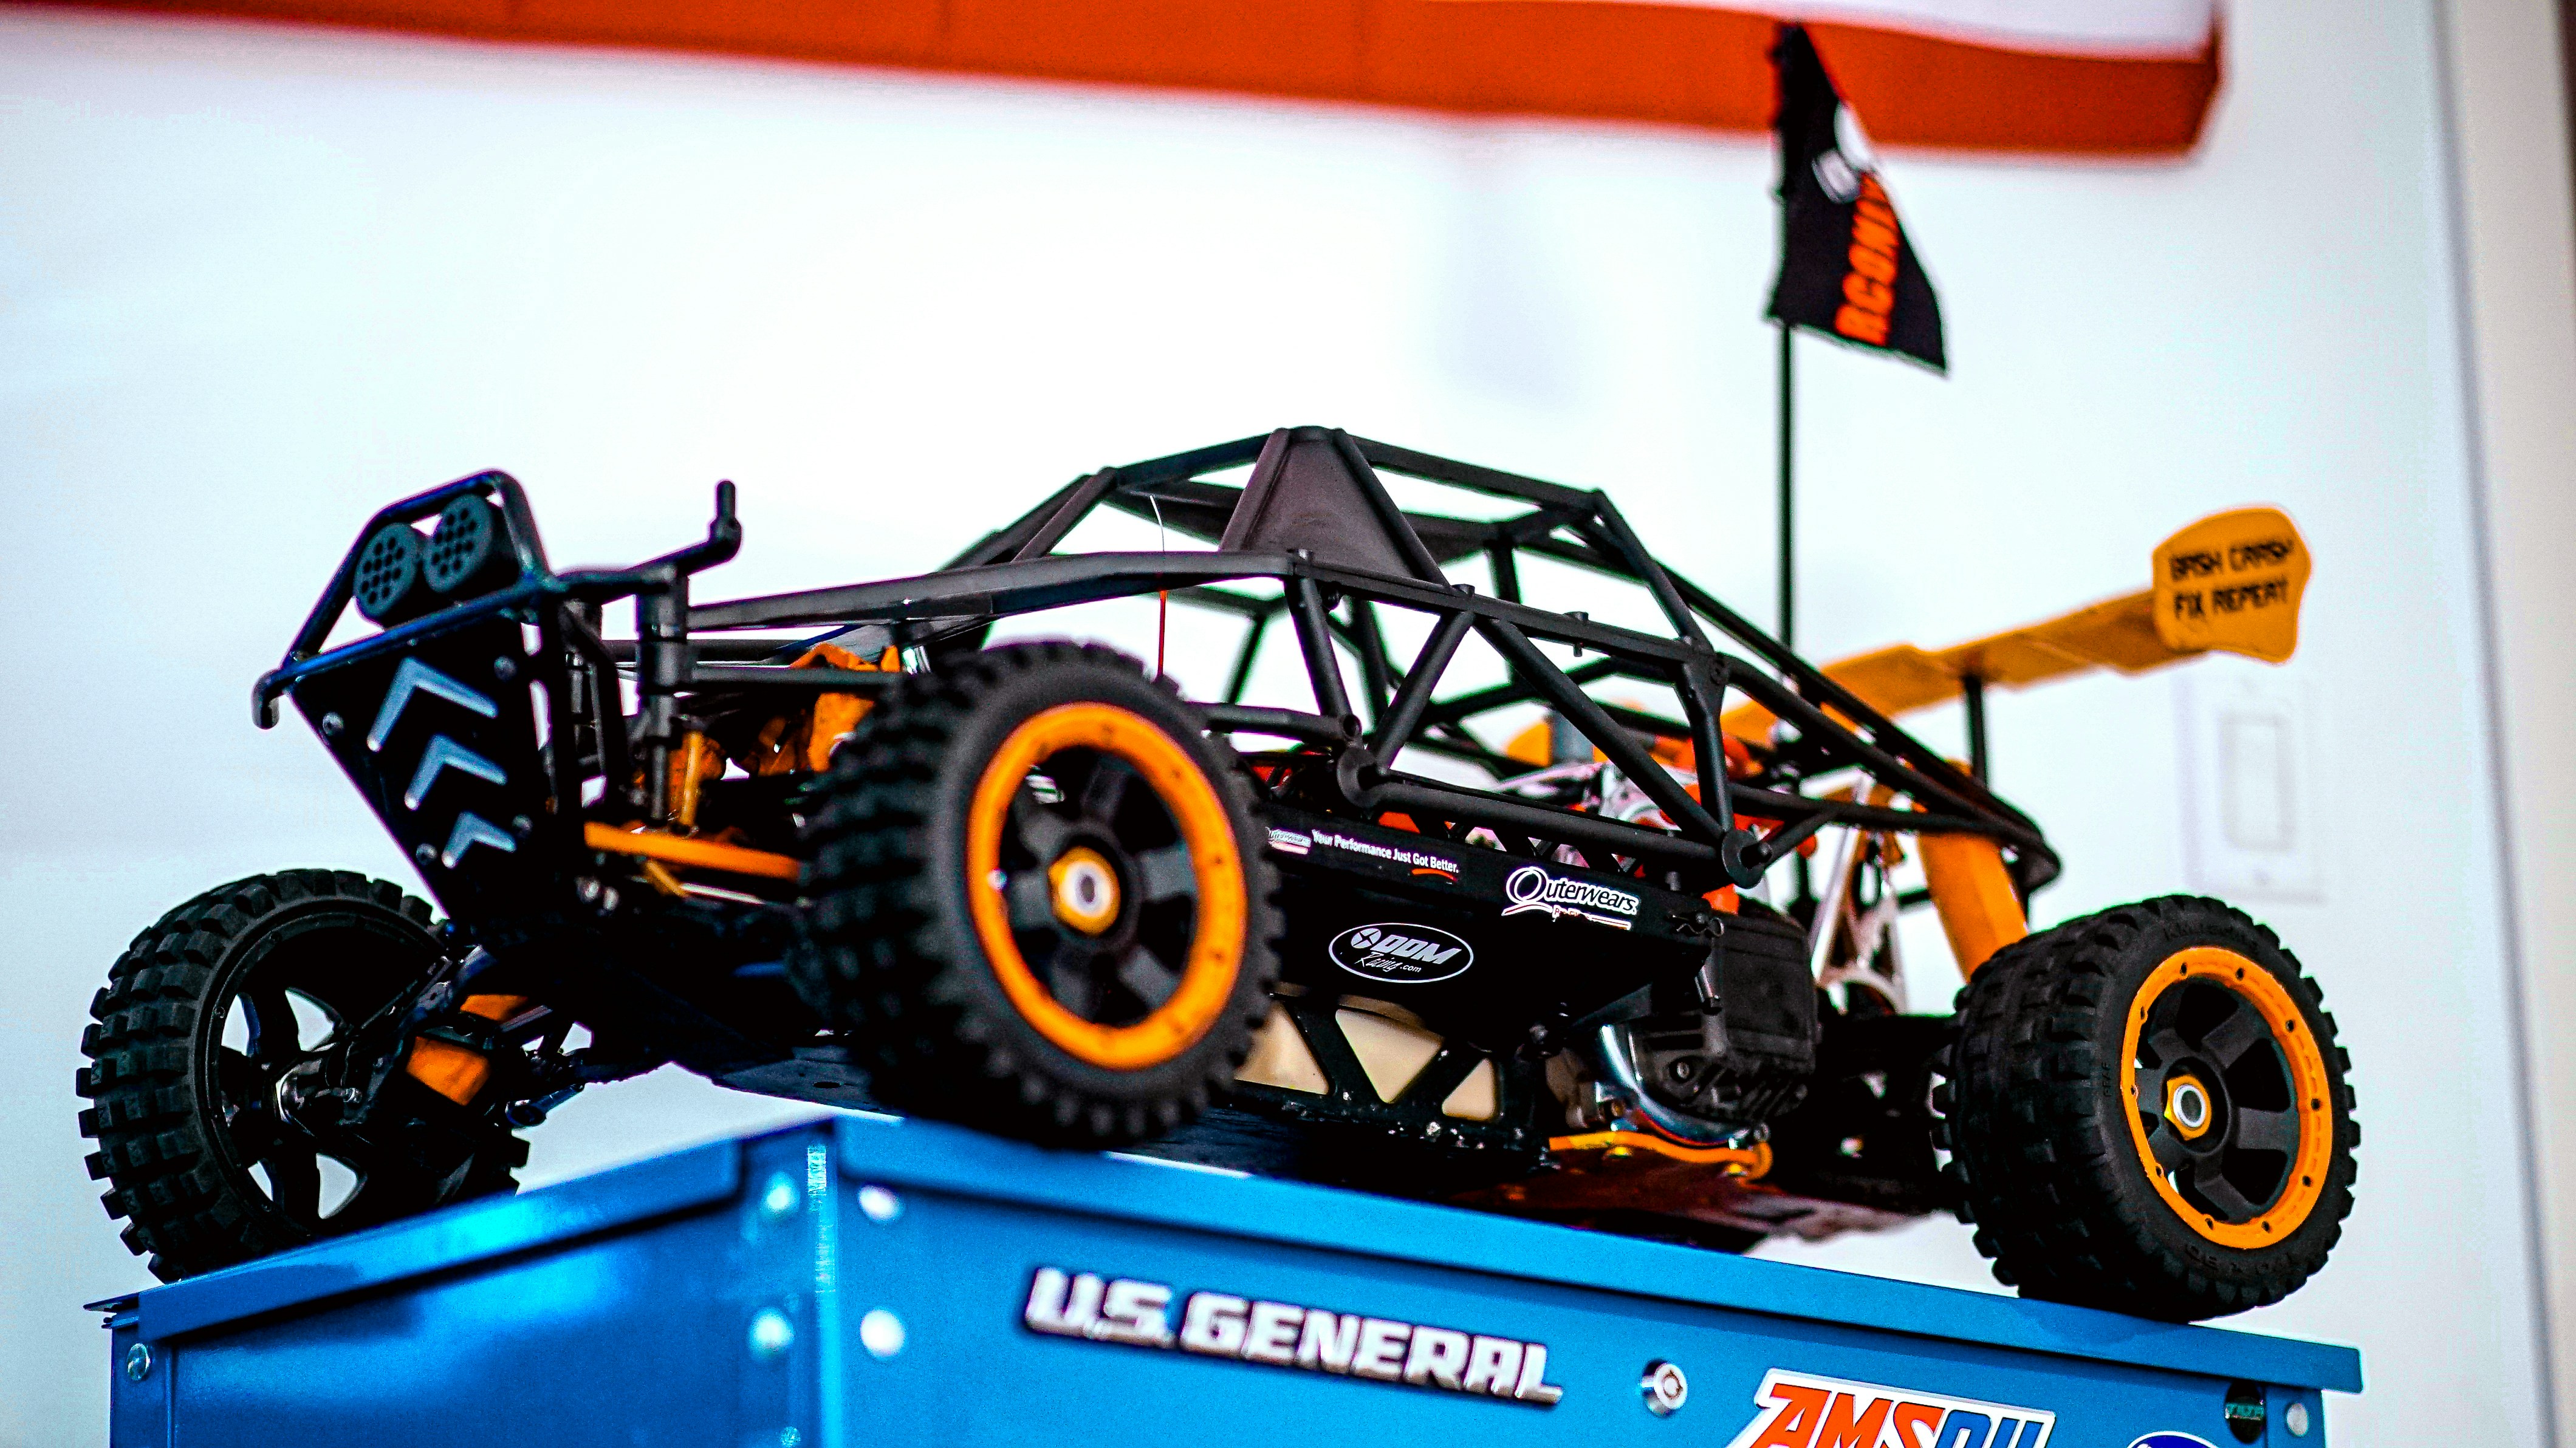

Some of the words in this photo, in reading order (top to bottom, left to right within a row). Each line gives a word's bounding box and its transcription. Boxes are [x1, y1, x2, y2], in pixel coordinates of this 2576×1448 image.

[2174, 591, 2208, 621] FIX
[2212, 575, 2289, 615] REPEAT
[1312, 829, 1334, 846] Your
[1334, 835, 1392, 859] Performance
[1392, 848, 1411, 863] Just
[1413, 853, 1428, 867] Got
[1430, 856, 1459, 873] Better.
[1370, 934, 1462, 965] DDM
[1024, 1266, 1174, 1349] U.S.
[1179, 1291, 1564, 1404] GENERAL
